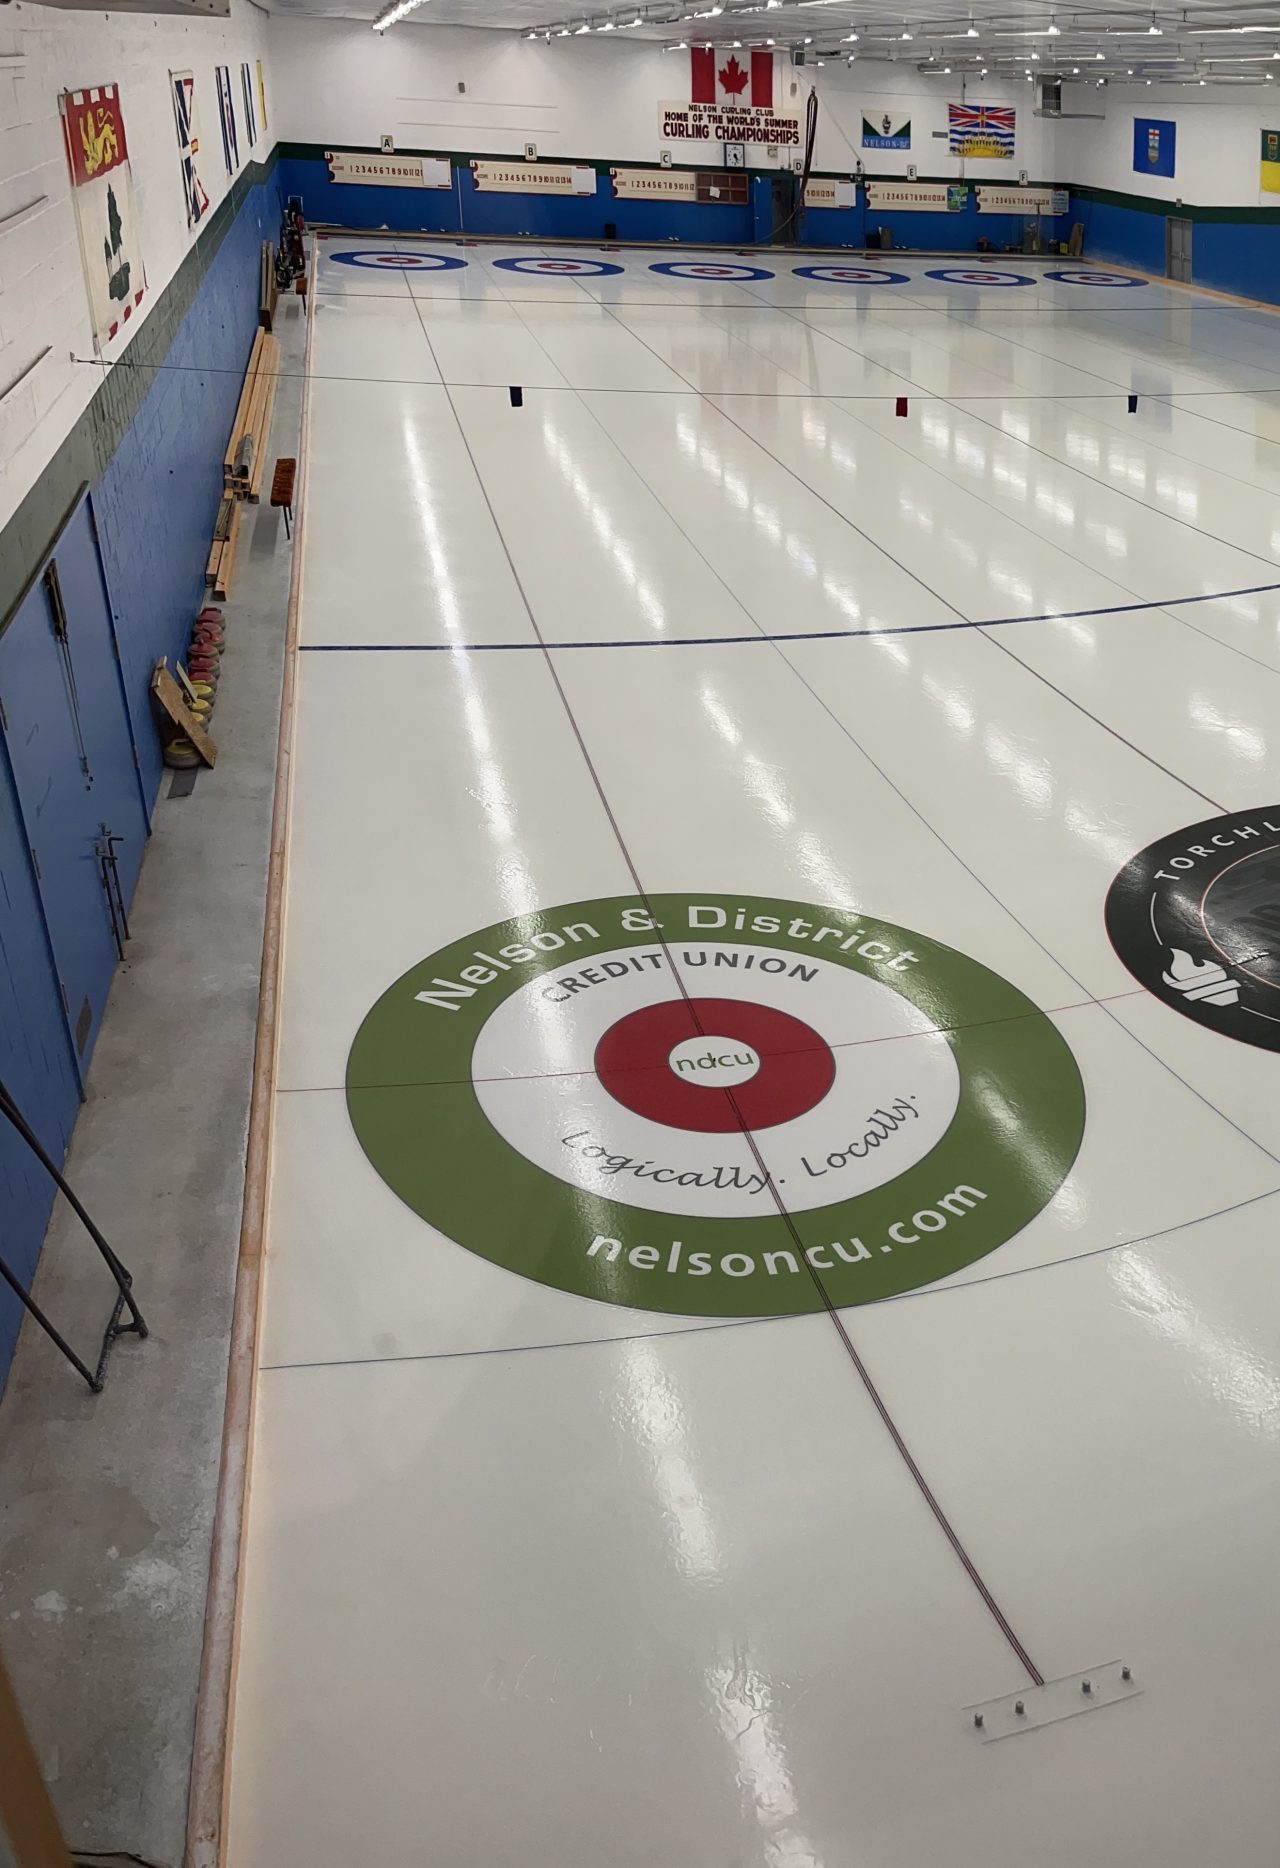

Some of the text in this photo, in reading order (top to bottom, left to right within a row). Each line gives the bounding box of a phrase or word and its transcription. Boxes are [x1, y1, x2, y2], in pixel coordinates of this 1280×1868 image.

[689, 105, 774, 117] NELSON CURLING CLUB
[665, 112, 798, 129] HOME OF THE WORLD'S SUMMER
[663, 122, 799, 144] CURLING CHAMPIONSHIPS
[384, 139, 390, 148] A
[528, 147, 533, 156] B
[663, 154, 668, 163] C
[796, 162, 802, 170] D
[909, 168, 914, 176] E
[413, 905, 920, 1012] Nelson & District
[541, 951, 819, 1003] CREDIT UNION
[676, 1049, 755, 1074] ndcu
[561, 1095, 919, 1194] Logically. Locally.
[586, 1183, 988, 1277] nelsoncu.com
